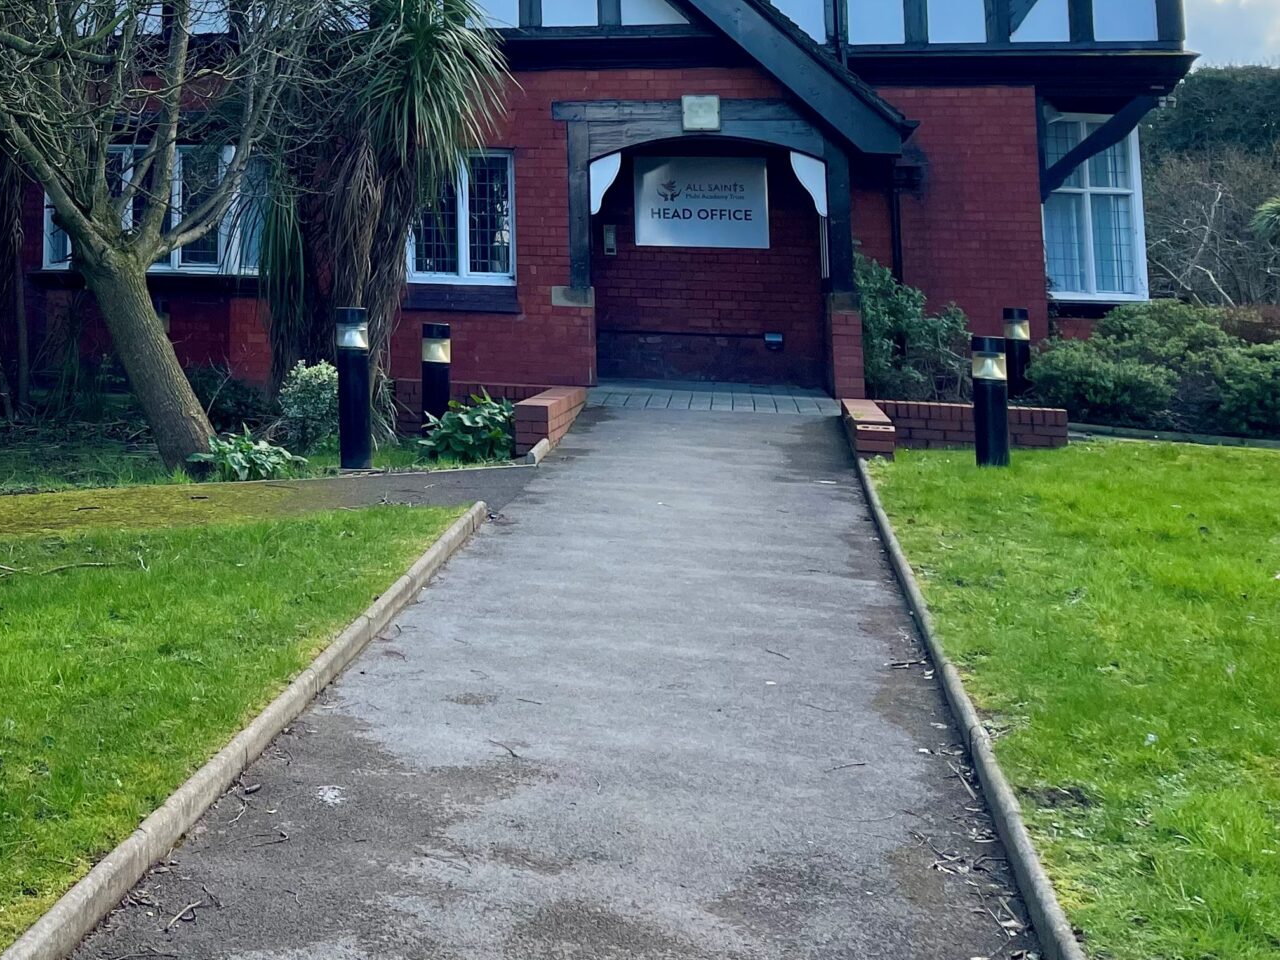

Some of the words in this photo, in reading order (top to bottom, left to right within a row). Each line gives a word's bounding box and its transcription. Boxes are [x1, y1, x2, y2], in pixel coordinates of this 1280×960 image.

[685, 183, 705, 193] ALL
[707, 181, 745, 193] SAINTS
[650, 208, 693, 220] HEAD
[697, 208, 753, 221] OFFICE
